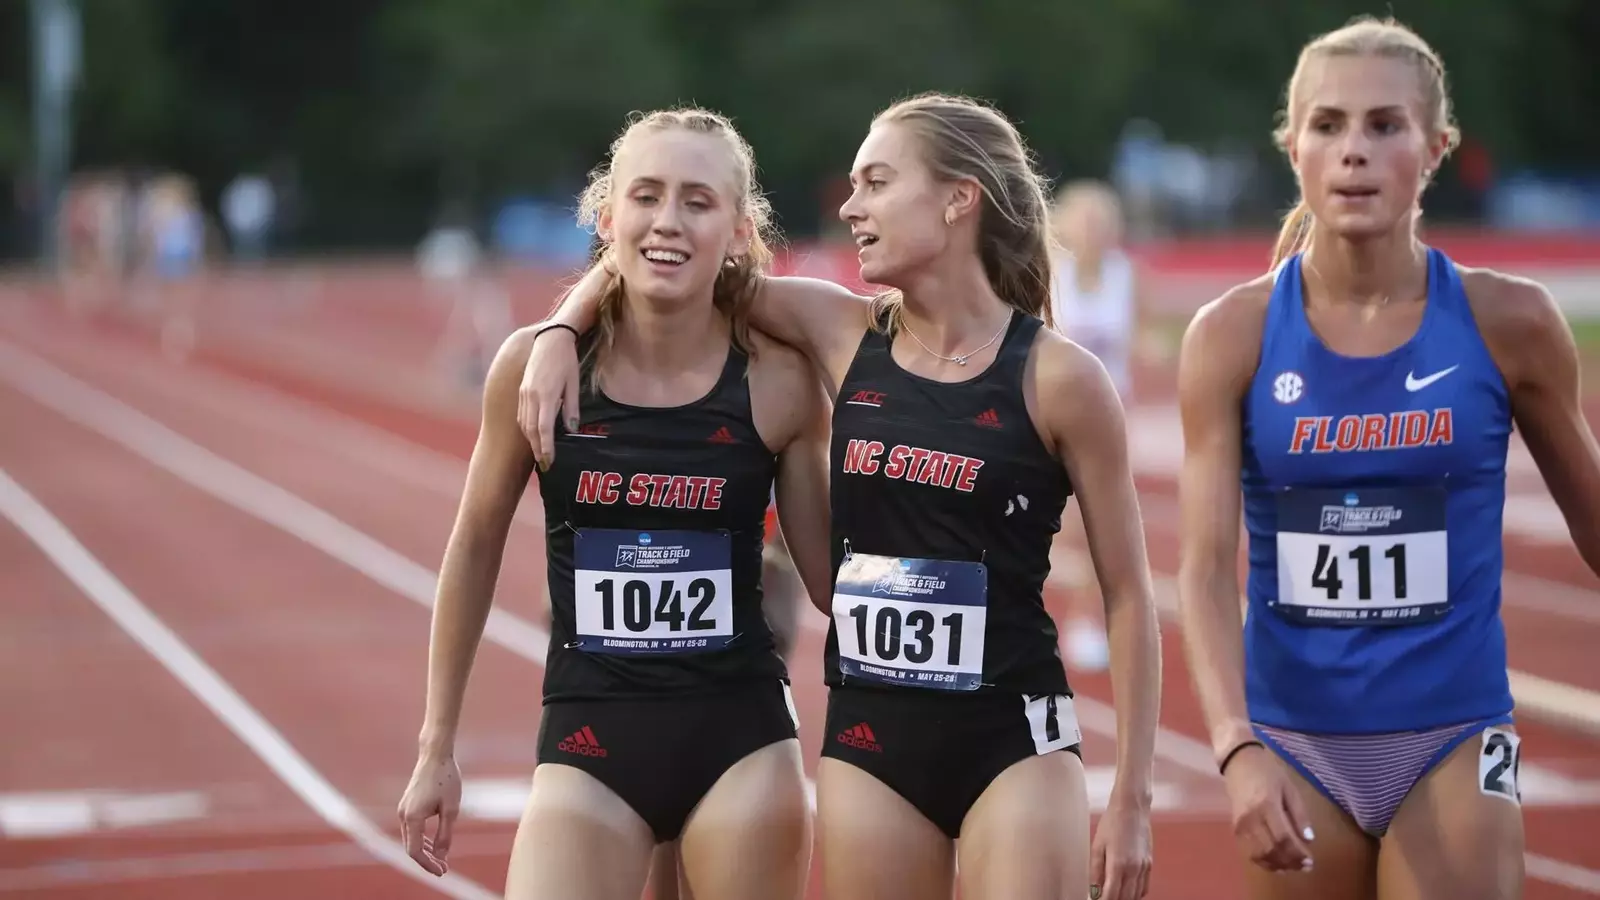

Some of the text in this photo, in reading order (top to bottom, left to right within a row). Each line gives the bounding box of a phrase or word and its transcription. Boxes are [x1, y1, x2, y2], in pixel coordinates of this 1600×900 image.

[851, 390, 887, 404] ACC
[1274, 372, 1303, 404] SEC
[1288, 408, 1453, 455] FLORIDA
[843, 438, 985, 493] NC STATE
[575, 470, 727, 510] NC STATE
[638, 550, 663, 558] TRACK
[669, 549, 690, 558] FIELD
[924, 579, 946, 590] FIELD
[1311, 543, 1407, 600] 411
[594, 578, 716, 633] 1042
[603, 638, 650, 649] BLOOMINGTON,
[670, 640, 686, 648] MAY
[686, 639, 707, 648] 25-28
[850, 604, 963, 666] 1031
[860, 663, 898, 678] BLOOMINGTON,
[917, 672, 933, 681] MAY
[558, 741, 607, 758] adidas
[838, 733, 883, 753] adidas
